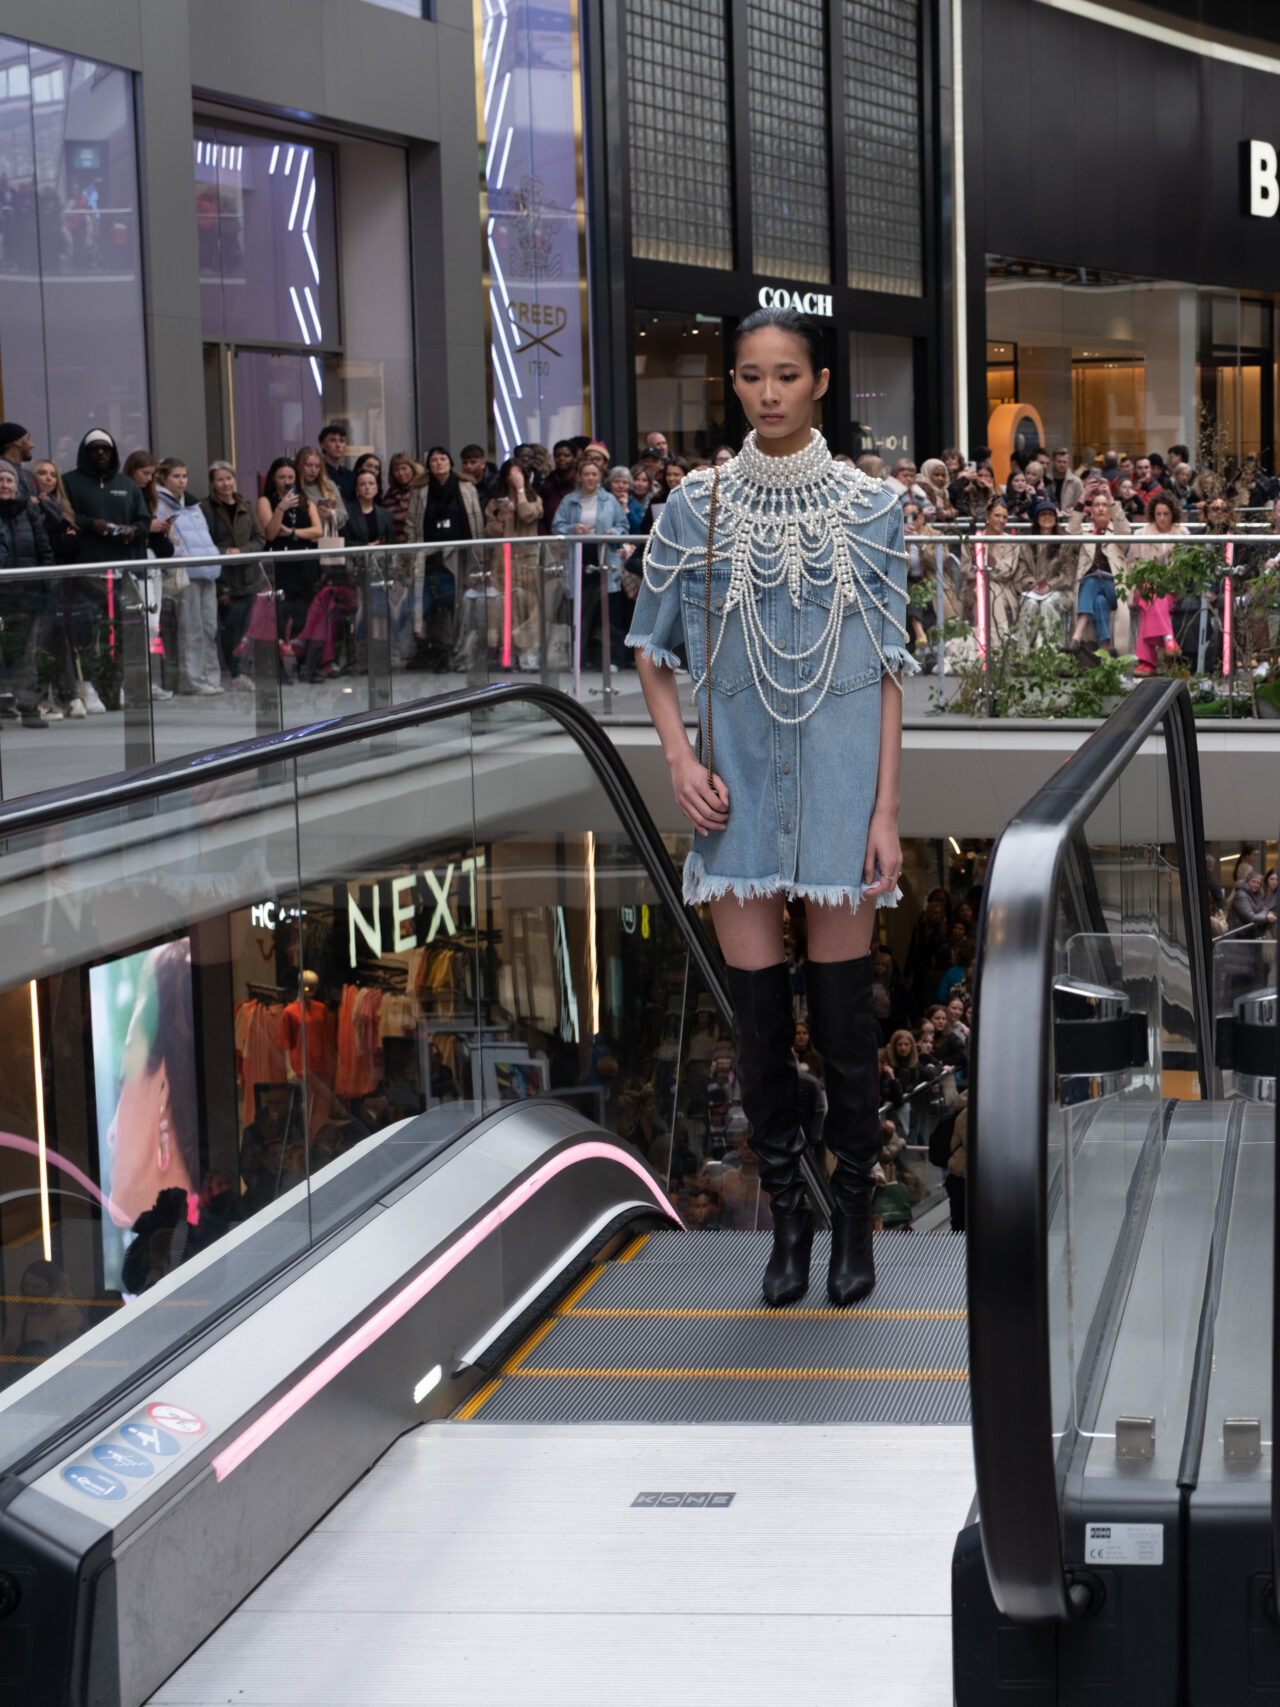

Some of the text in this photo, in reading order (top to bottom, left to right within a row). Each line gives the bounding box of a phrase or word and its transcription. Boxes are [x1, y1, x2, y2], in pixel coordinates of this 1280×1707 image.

[507, 300, 568, 328] CREED
[758, 286, 834, 317] COACH
[347, 855, 486, 969] NEXT
[634, 1494, 733, 1505] KONE
